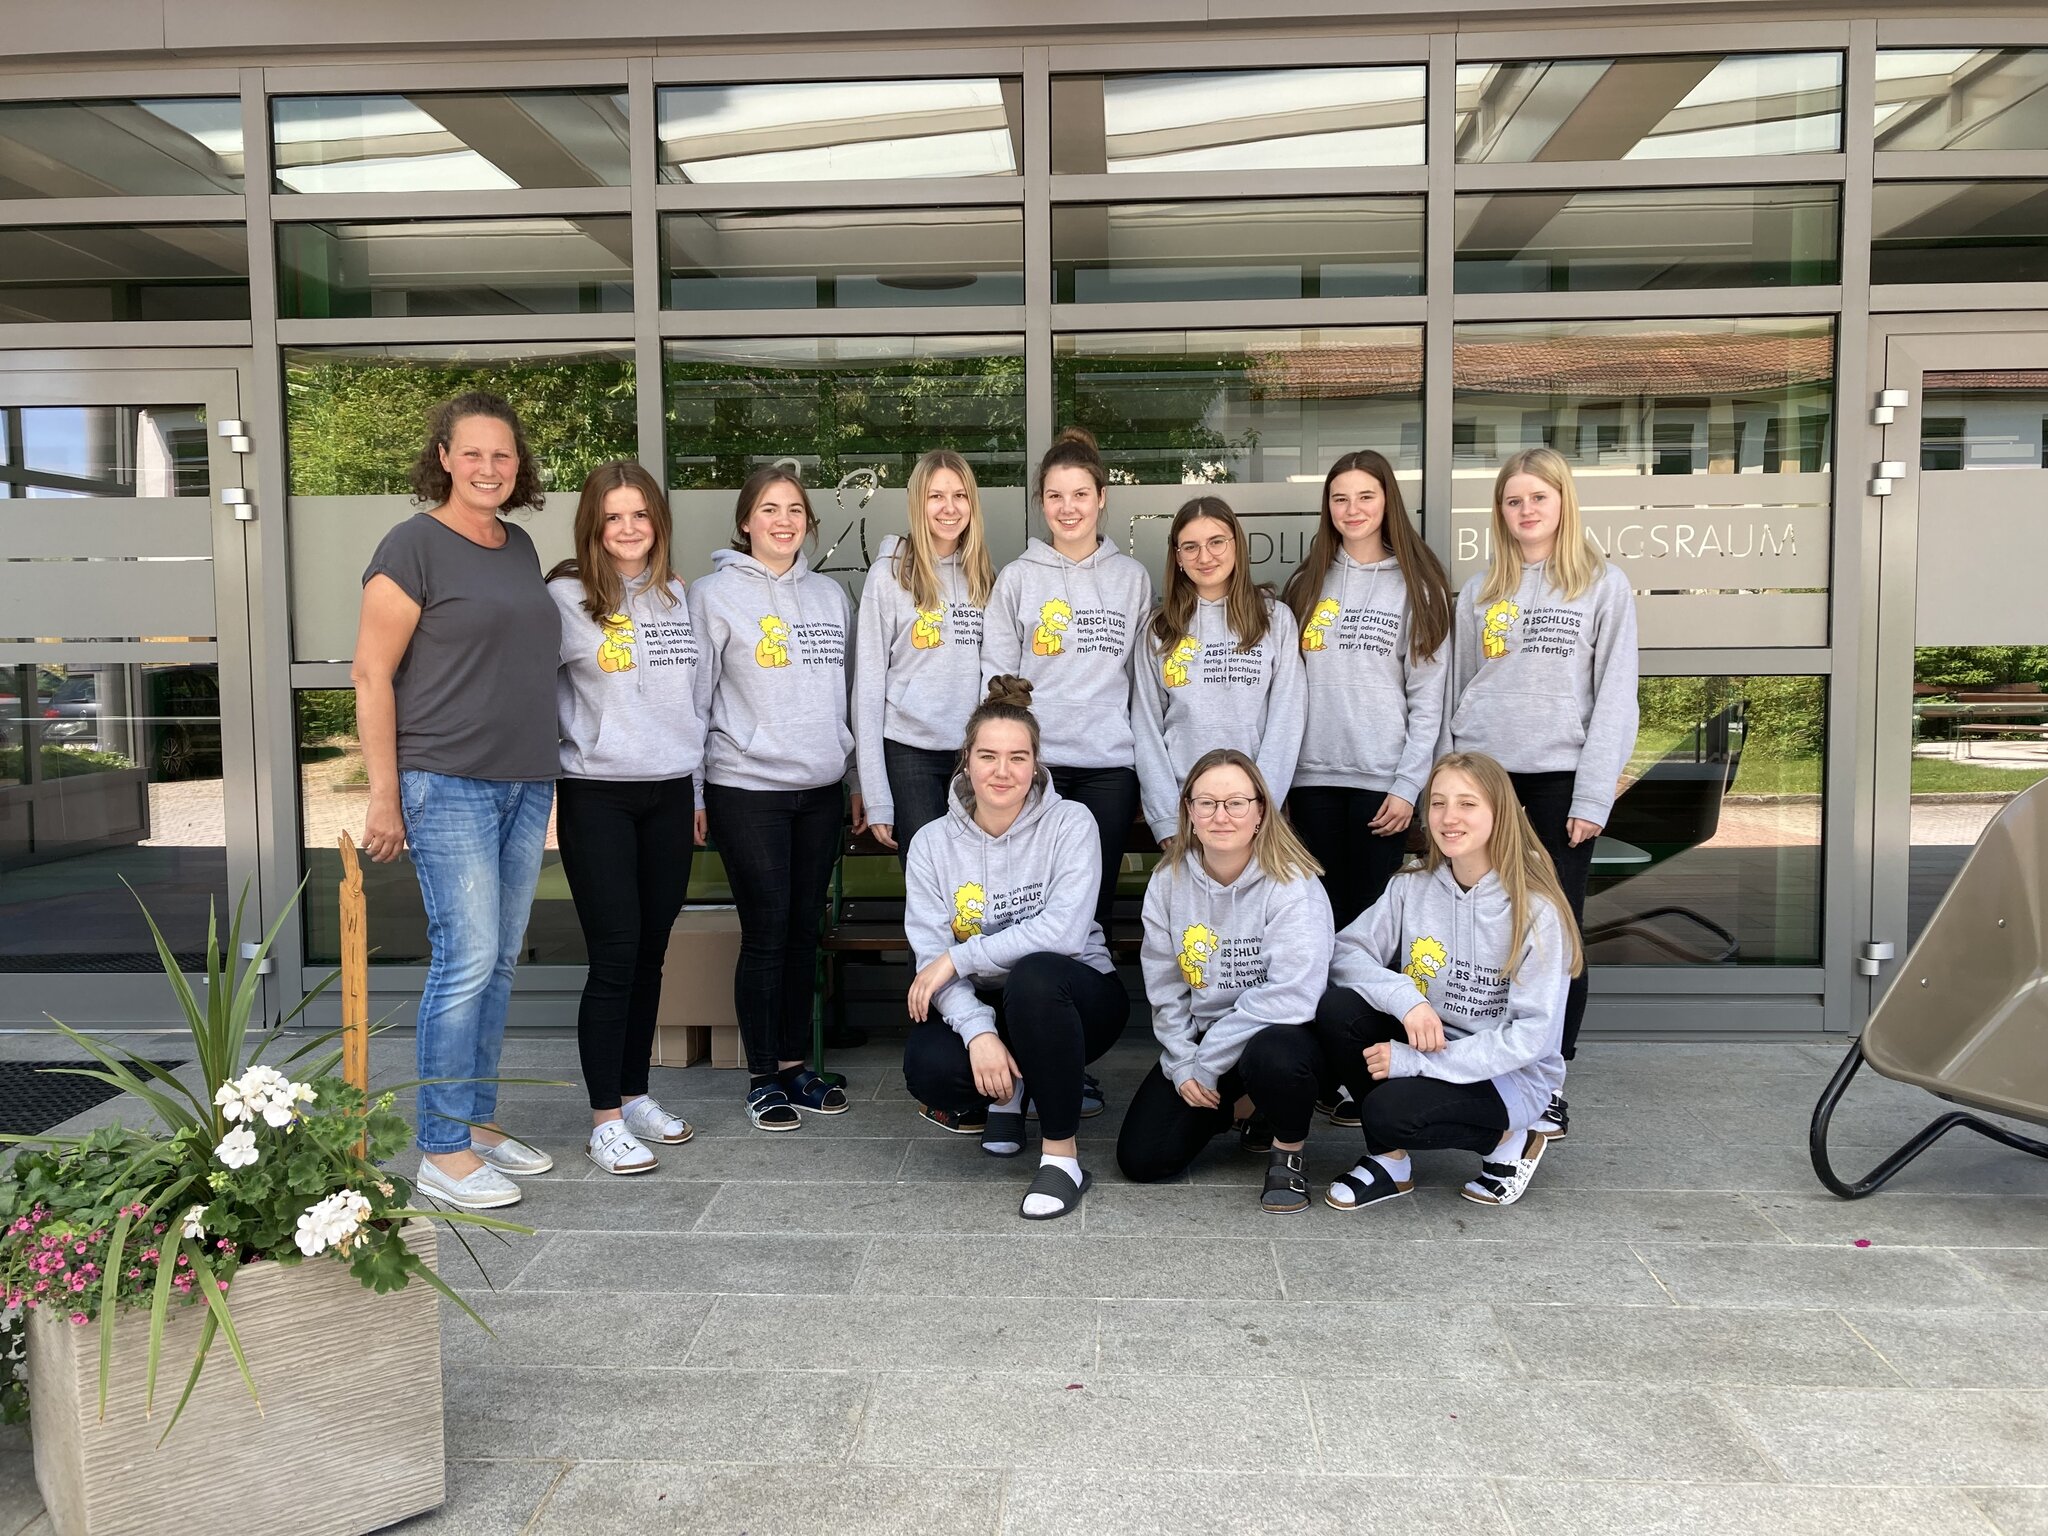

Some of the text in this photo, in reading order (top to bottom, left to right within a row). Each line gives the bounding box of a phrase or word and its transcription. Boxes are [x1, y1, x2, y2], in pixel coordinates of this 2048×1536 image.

[1457, 523, 1797, 559] BINGSRAUM
[952, 610, 984, 619] ABSCH
[1376, 610, 1401, 620] meinen
[1554, 608, 1583, 618] meinen
[644, 628, 694, 639] ABCHLUS
[1077, 627, 1095, 635] fertig,
[1376, 627, 1397, 638] macht
[1556, 627, 1580, 637] macht
[955, 637, 976, 645] mich
[1095, 635, 1125, 646] Abschluss
[1360, 633, 1394, 647] Abschluss
[1537, 635, 1576, 645] Abschluss
[648, 647, 669, 656] mein
[1076, 644, 1097, 653] mich
[1363, 642, 1391, 657] fertg?!
[1541, 644, 1575, 658] fertig?!
[649, 657, 674, 667] mich
[802, 656, 824, 665] mch
[1240, 658, 1262, 666] macht
[1203, 665, 1222, 673] mein
[1203, 674, 1260, 686] mich fertig?!
[1022, 882, 1043, 891] meine
[993, 891, 1042, 911] ABCHLUS
[1233, 959, 1249, 967] oder
[1450, 956, 1470, 968] ach
[1446, 979, 1468, 992] fertig,
[1469, 985, 1487, 995] oder
[1445, 991, 1509, 1006] mein Abschluss
[1443, 1001, 1508, 1018] mich fertig?!
